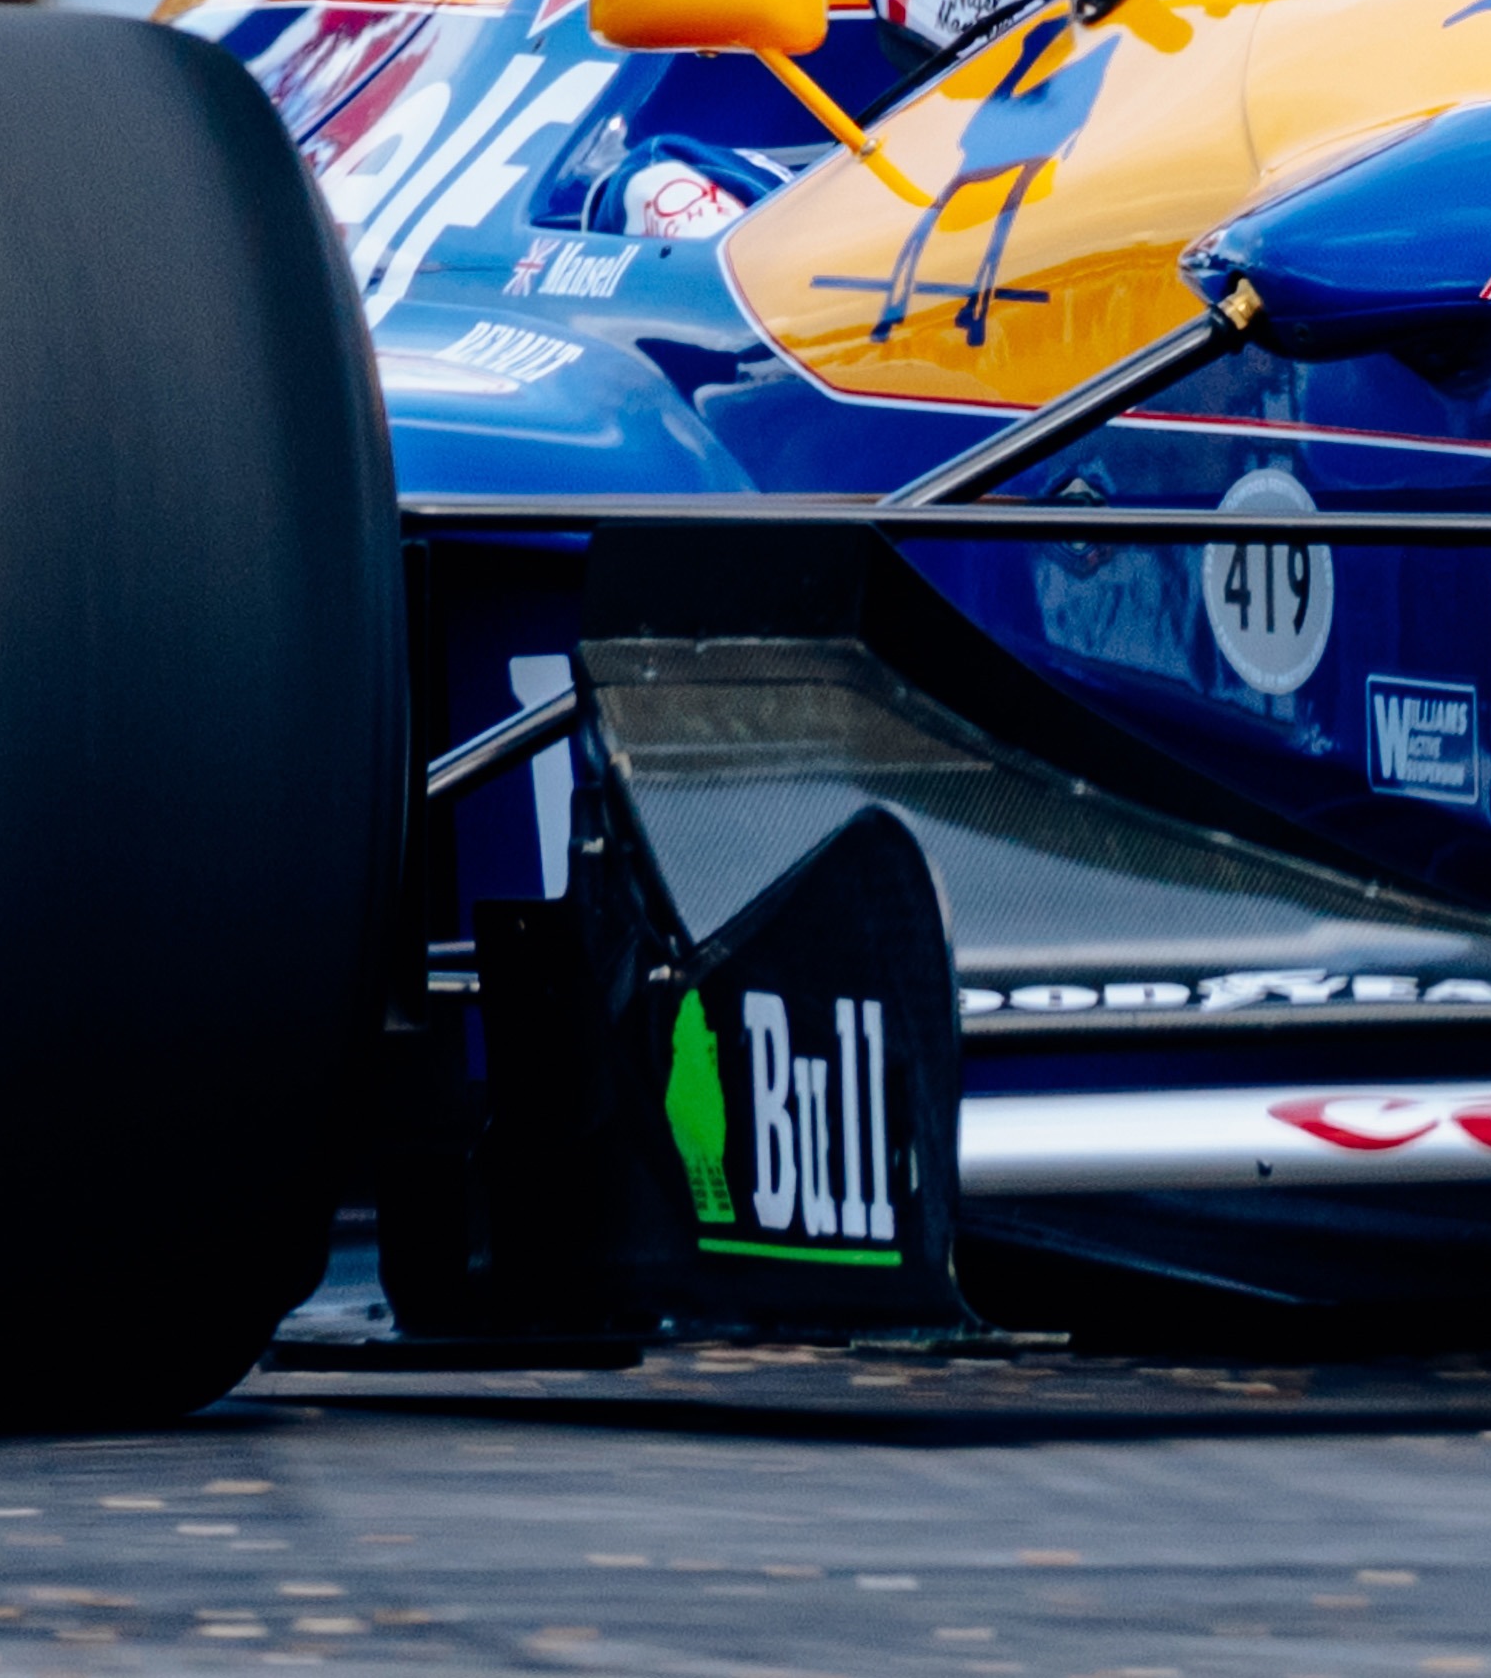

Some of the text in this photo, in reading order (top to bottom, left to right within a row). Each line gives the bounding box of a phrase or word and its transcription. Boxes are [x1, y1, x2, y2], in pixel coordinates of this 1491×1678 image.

[537, 240, 641, 298] Mansell
[1224, 543, 1312, 637] 419
[743, 989, 896, 1241] Bull
